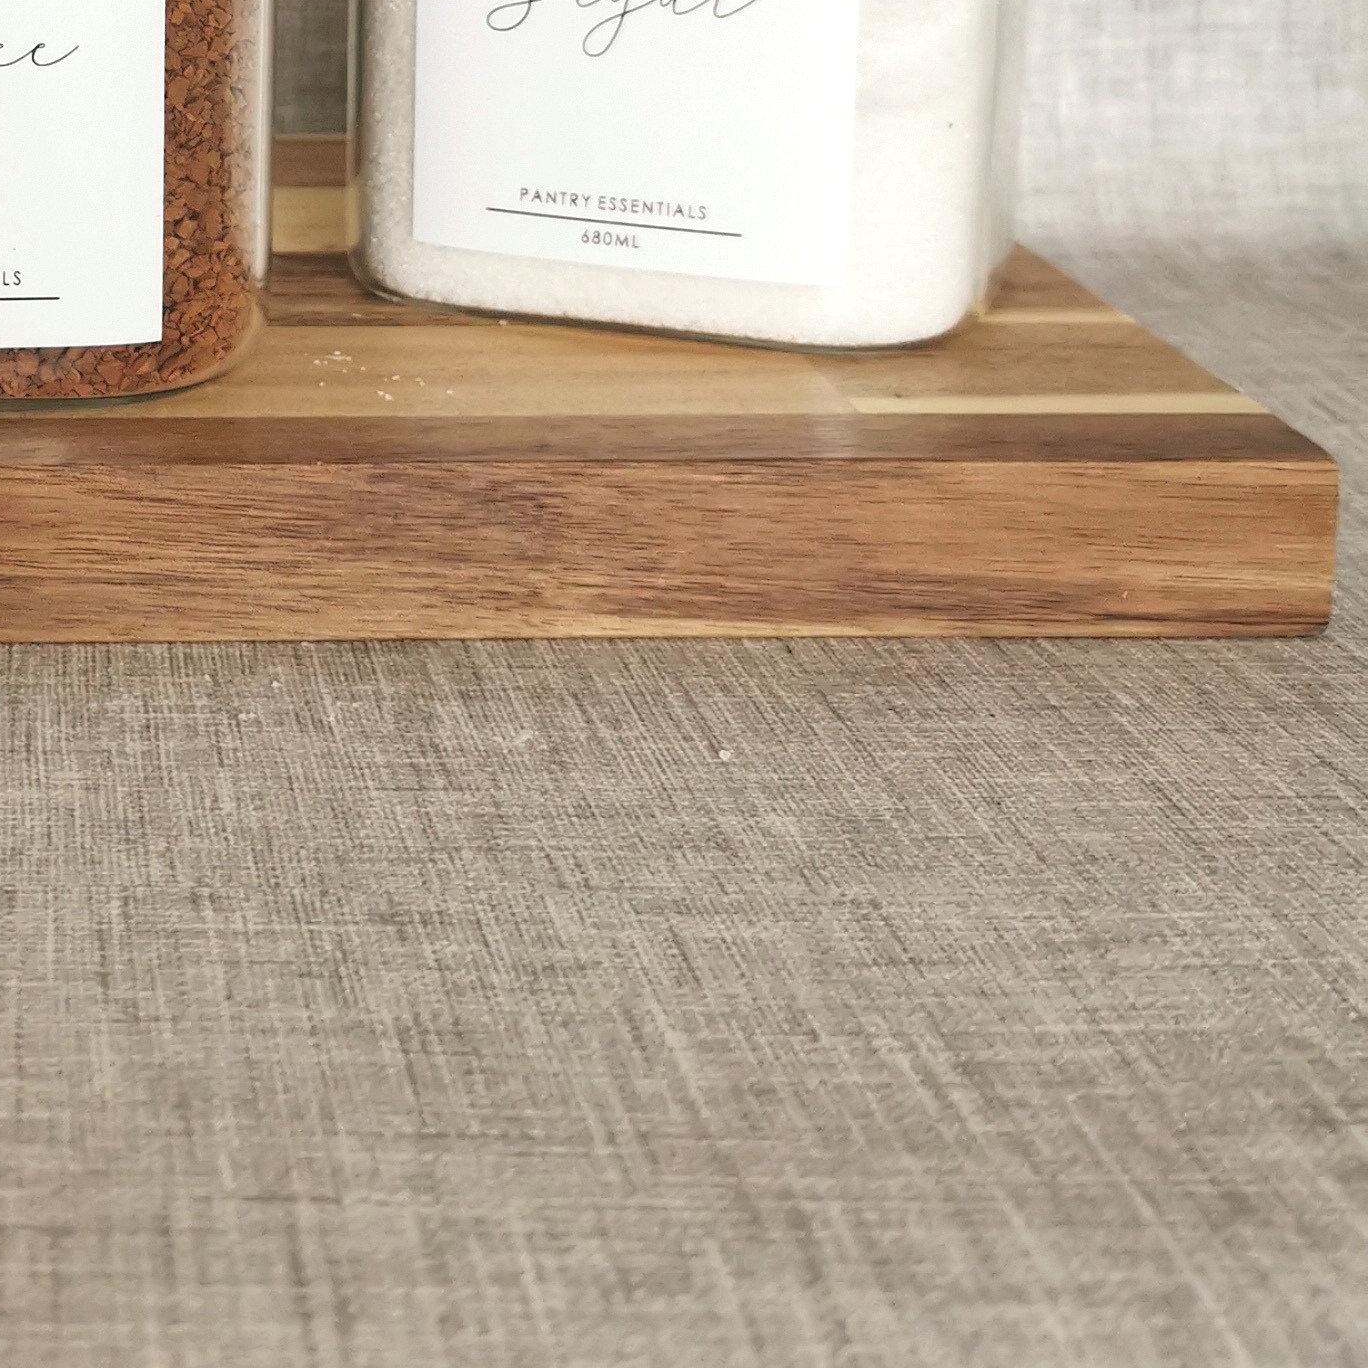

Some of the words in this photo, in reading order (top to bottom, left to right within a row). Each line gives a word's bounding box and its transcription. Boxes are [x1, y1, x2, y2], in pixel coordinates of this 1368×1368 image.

[519, 186, 592, 209] PANTRY
[597, 195, 707, 221] ESSENTIALS
[580, 229, 641, 250] 680ML
